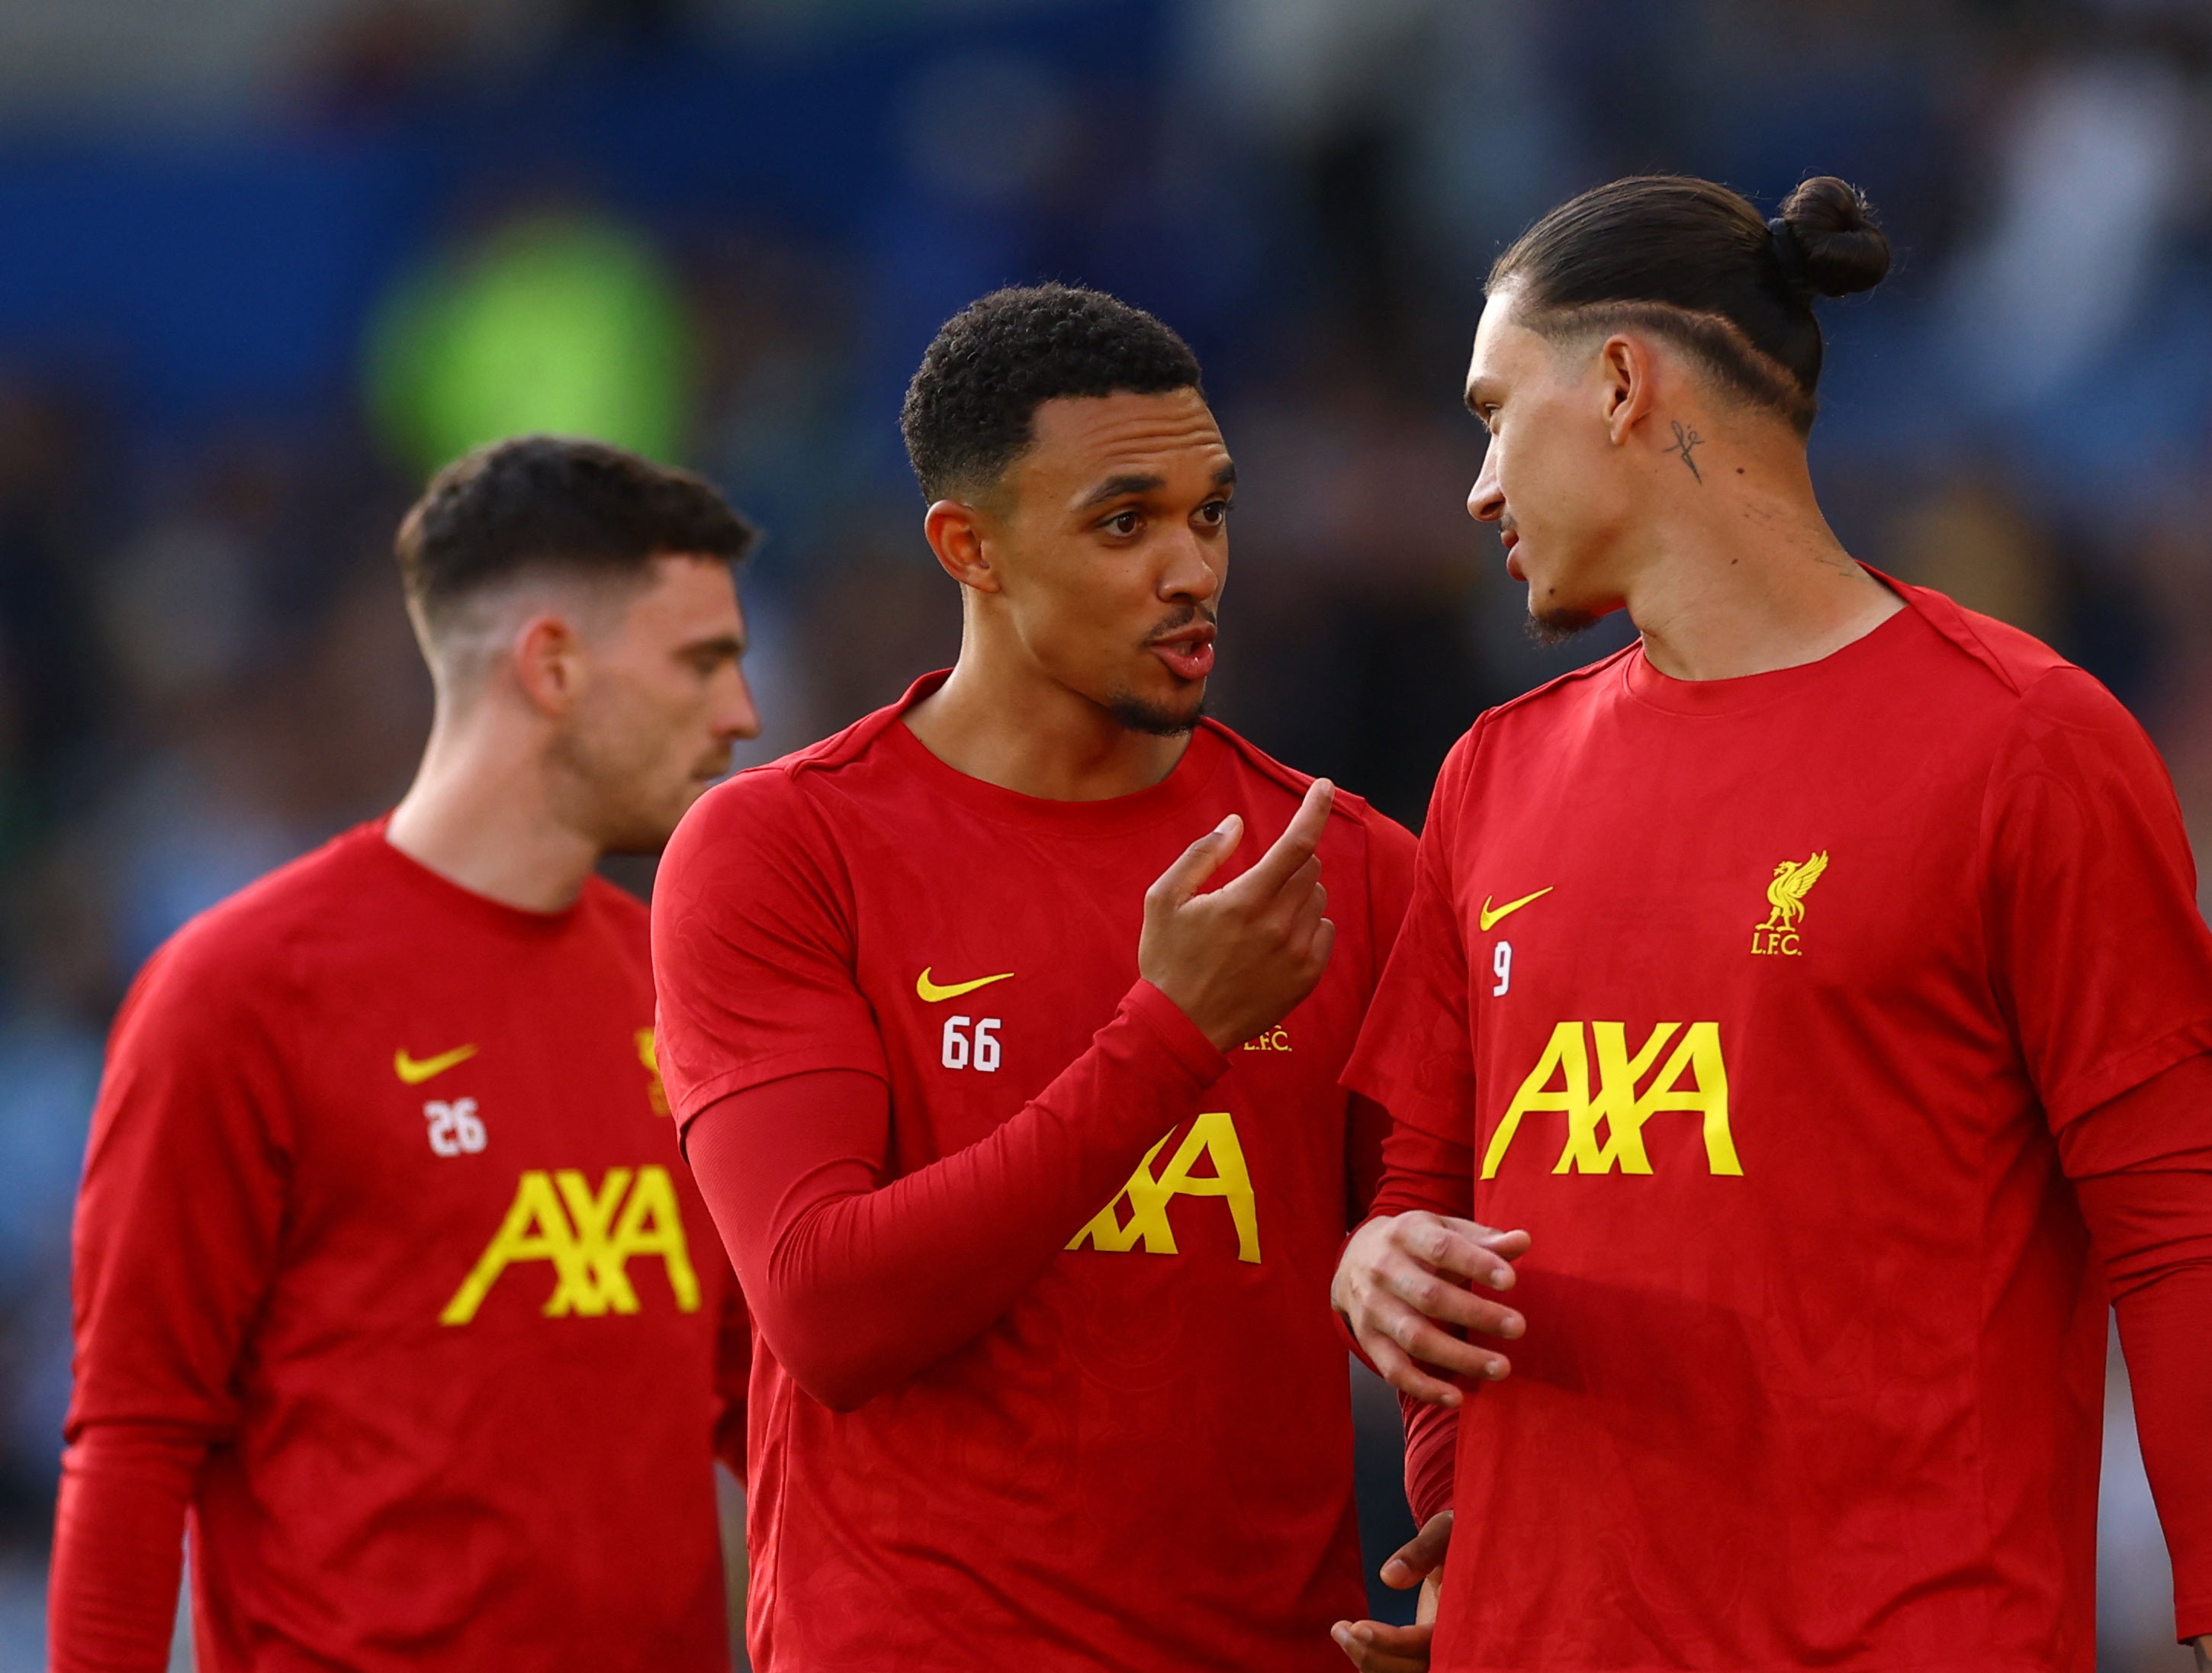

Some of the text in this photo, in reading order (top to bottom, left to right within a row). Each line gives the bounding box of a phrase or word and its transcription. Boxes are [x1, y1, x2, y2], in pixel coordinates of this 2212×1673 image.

[1493, 941, 1512, 997] 9
[1751, 932, 1802, 956] L.F.C.
[942, 1015, 1002, 1072] 66
[423, 1096, 487, 1158] 26
[1480, 1021, 1744, 1181] AXA
[1063, 1112, 1262, 1264] XA
[439, 1163, 703, 1327] AXA
